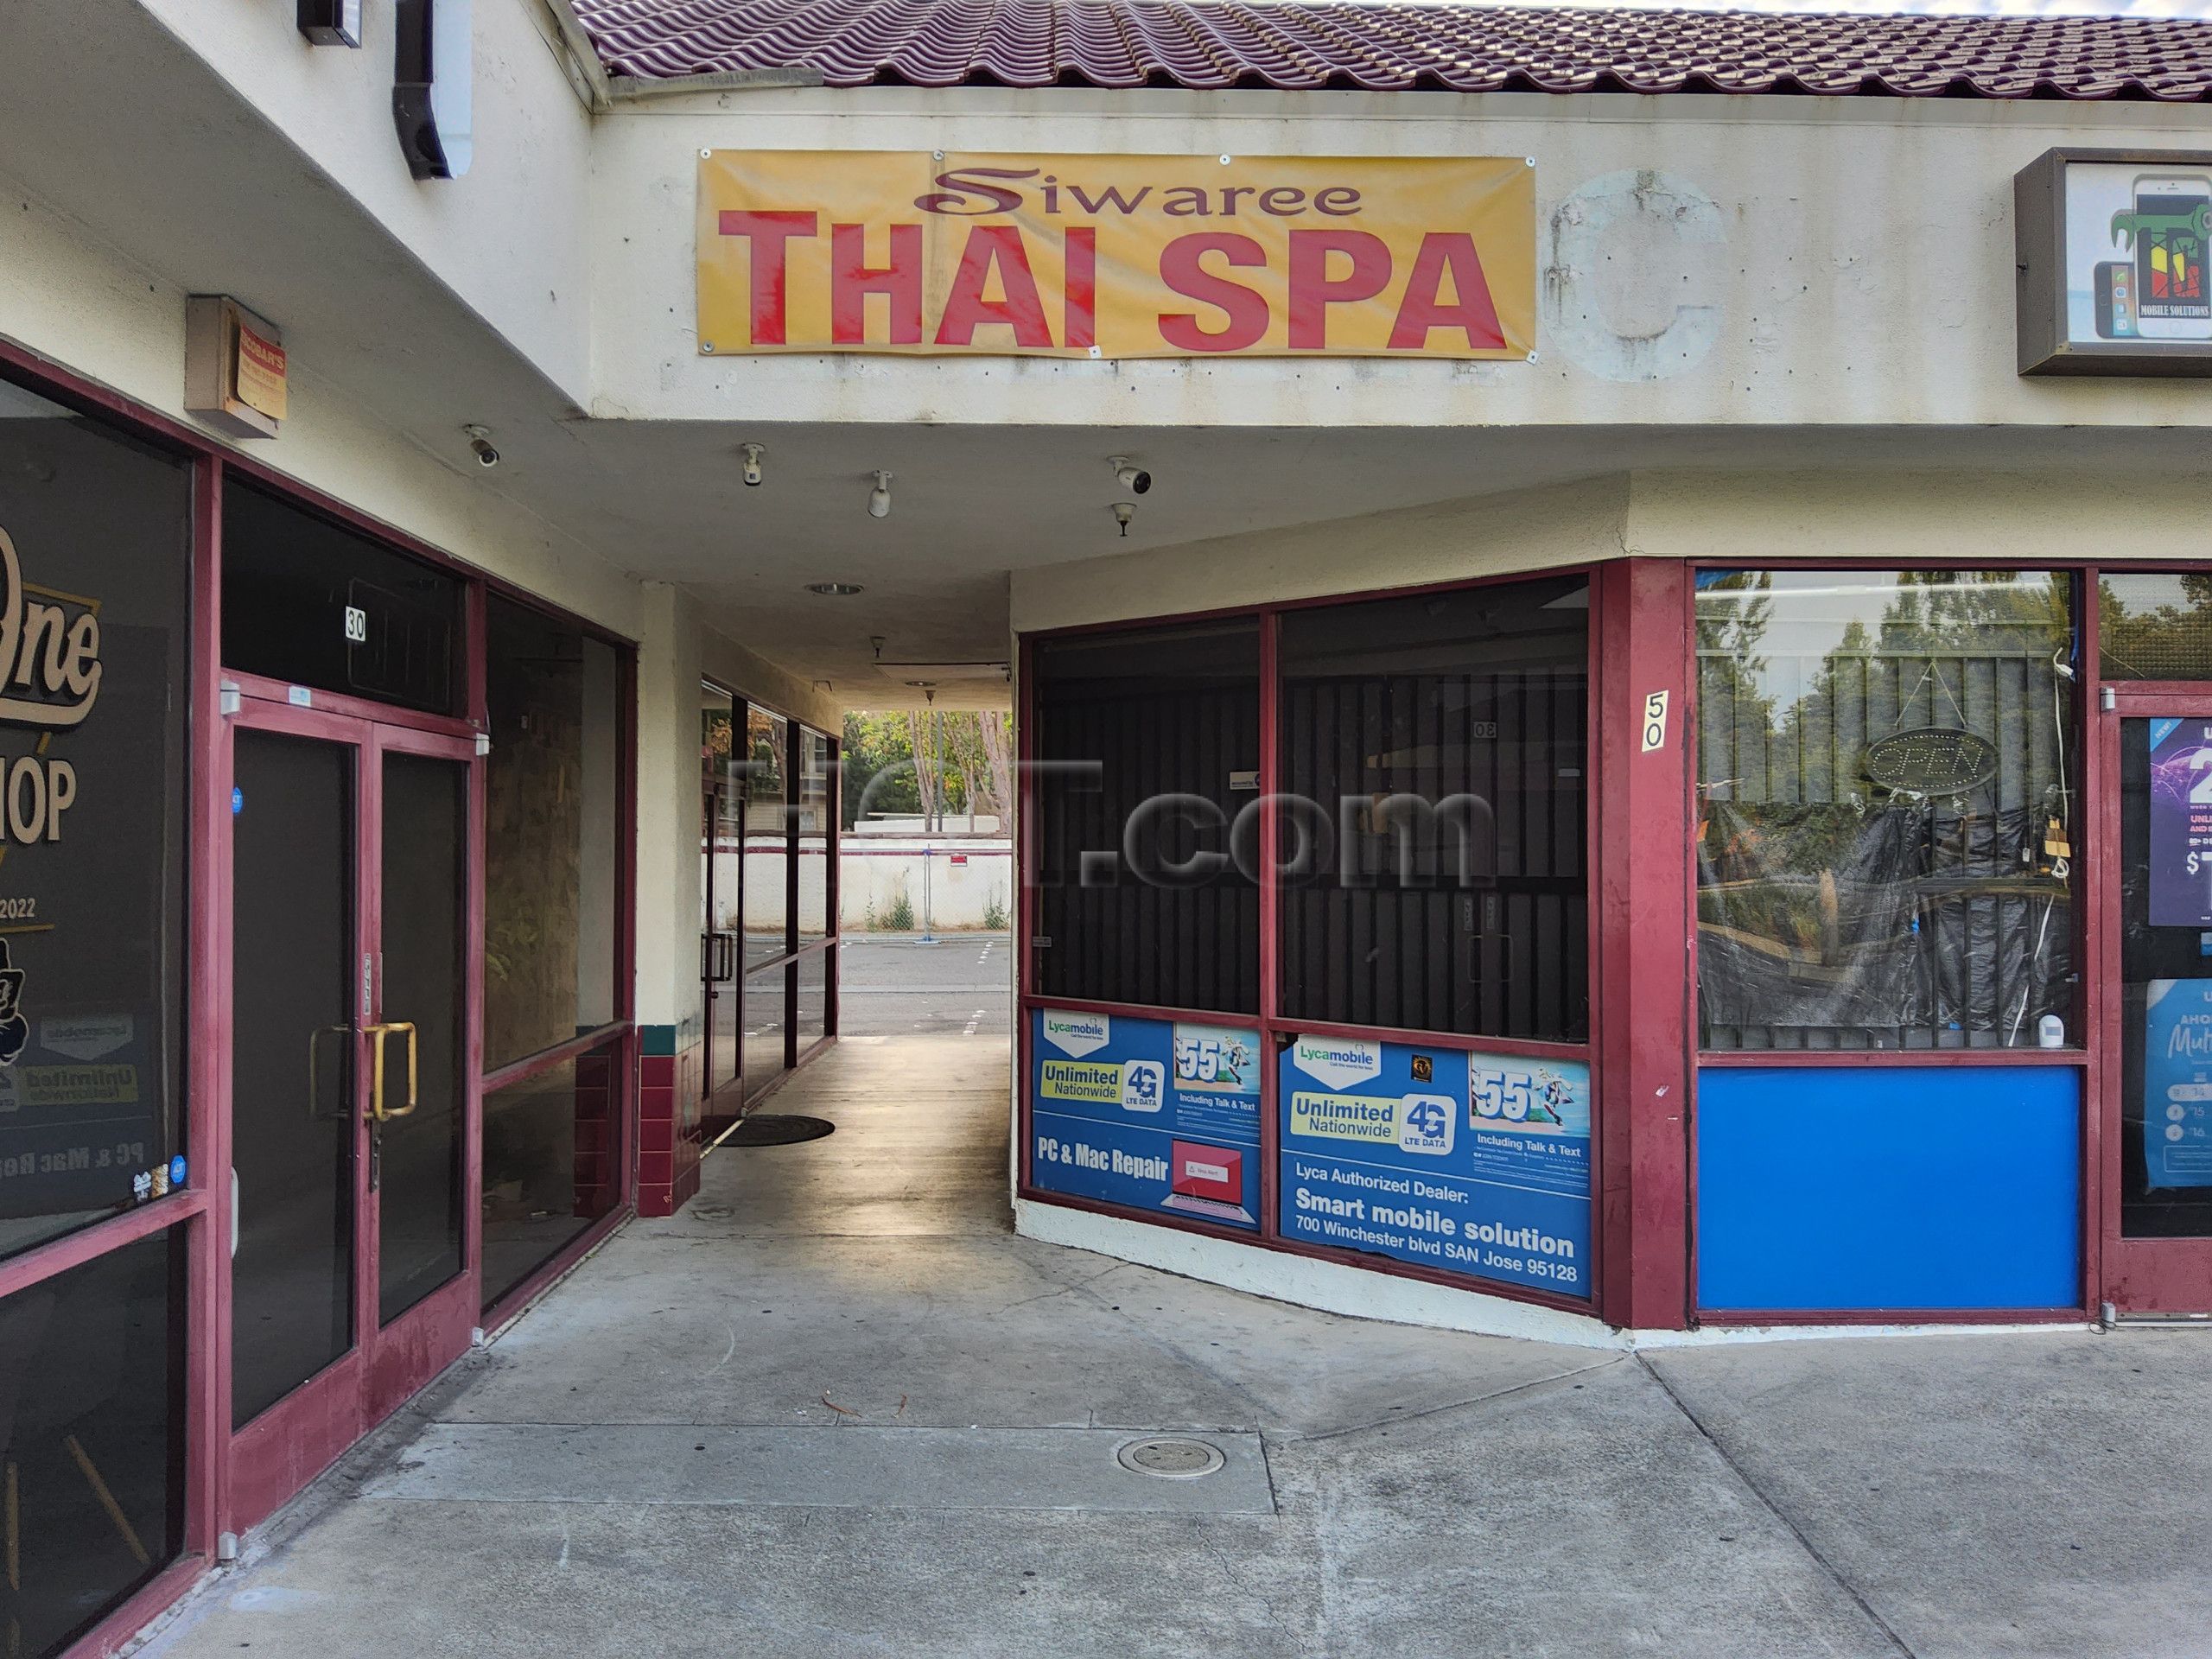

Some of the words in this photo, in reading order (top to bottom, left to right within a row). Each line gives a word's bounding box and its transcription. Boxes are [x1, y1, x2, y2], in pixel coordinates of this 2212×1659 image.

[912, 168, 1363, 216] Siwaree
[717, 209, 1097, 349] THAI
[1157, 227, 1508, 353] SPA
[2140, 304, 2169, 316] MOBILE
[2170, 305, 2209, 317] SOLUTIONS
[347, 608, 364, 639] 30
[1645, 693, 1665, 747] 50
[1872, 743, 1983, 779] OPEN
[1048, 1020, 1103, 1036] Lycamobile
[1300, 1045, 1374, 1065] Lycamobile
[1046, 1065, 1119, 1085] Unlimited
[1128, 1065, 1158, 1098] 4G
[1055, 1082, 1116, 1098] Nationwide
[1139, 1098, 1157, 1107] DATA
[1179, 1093, 1213, 1107] Including
[1214, 1097, 1230, 1109] Talk
[1231, 1100, 1238, 1109] &
[1238, 1101, 1255, 1111] Text
[1296, 1097, 1394, 1122] Unlimited
[1407, 1101, 1446, 1139] 4G
[1309, 1116, 1391, 1138] Nationwide
[1422, 1138, 1446, 1148] DATA
[1477, 1133, 1522, 1151] Including
[1524, 1140, 1546, 1153] Talk
[1548, 1143, 1556, 1154] &
[1559, 1144, 1581, 1158] Text
[1038, 1136, 1058, 1162] PC
[1061, 1145, 1072, 1164] &
[1075, 1142, 1109, 1172] Mac
[1112, 1148, 1168, 1182] Repair
[1296, 1162, 1328, 1182] Lyca
[1332, 1168, 1409, 1195] Authorized
[1414, 1180, 1469, 1204] Dealer:
[1296, 1187, 1365, 1220] Smart
[1372, 1202, 1456, 1236] mobile
[1465, 1218, 1574, 1258] solution
[1296, 1215, 1320, 1233] 700
[1324, 1220, 1404, 1249] Winchester
[1408, 1235, 1440, 1257] blvd
[1445, 1242, 1478, 1263] SAN
[1483, 1249, 1523, 1273] Jose
[1527, 1258, 1578, 1283] 95128
